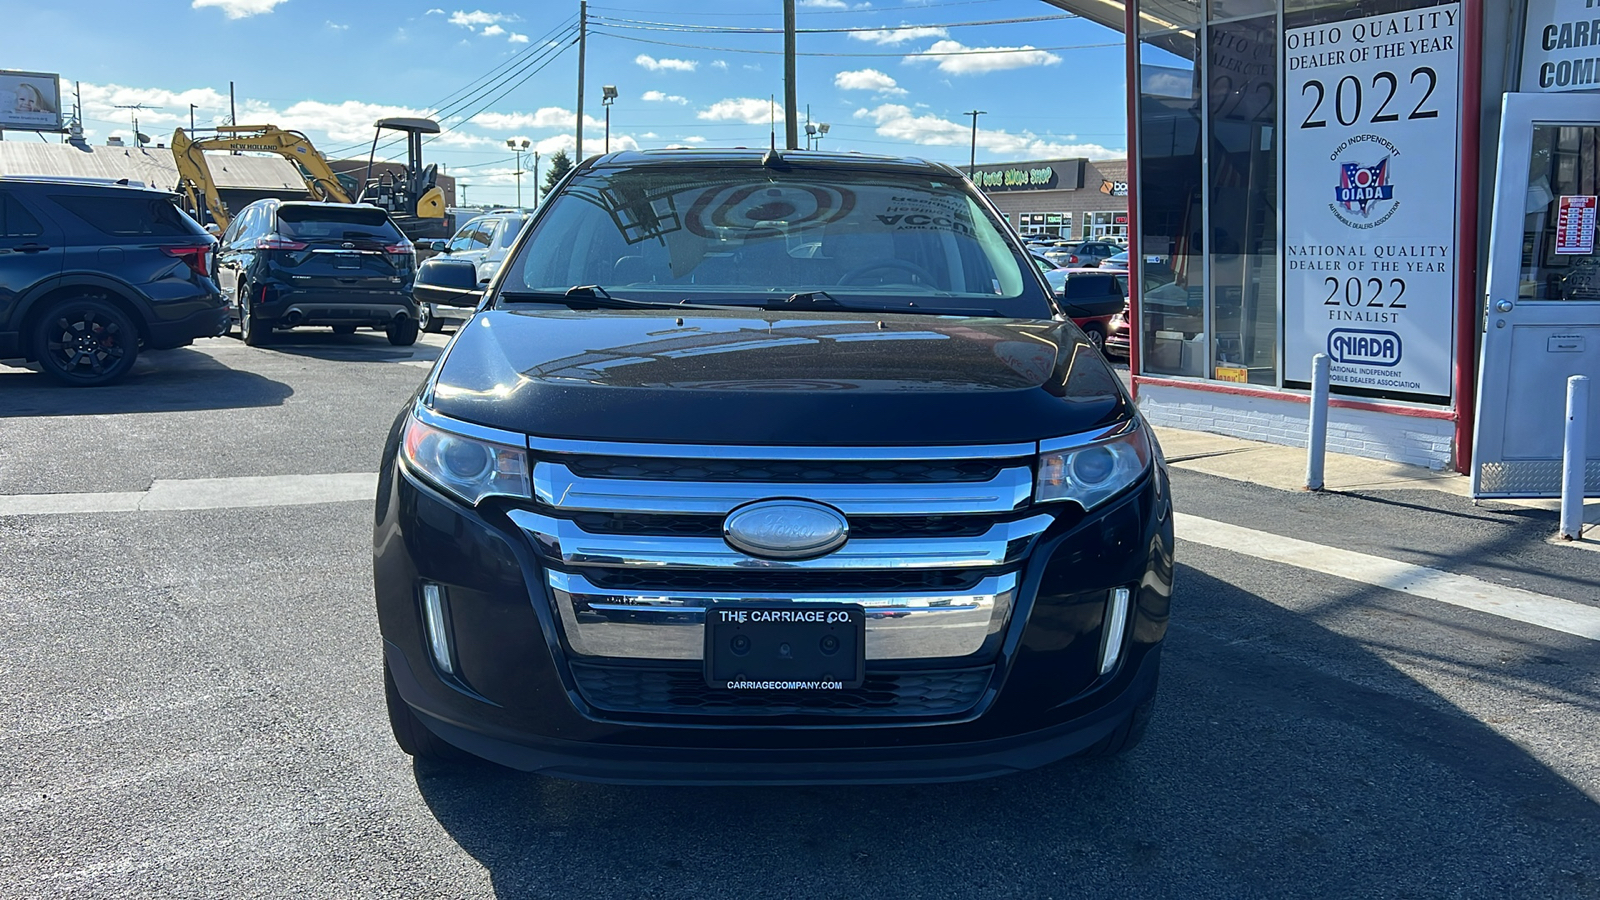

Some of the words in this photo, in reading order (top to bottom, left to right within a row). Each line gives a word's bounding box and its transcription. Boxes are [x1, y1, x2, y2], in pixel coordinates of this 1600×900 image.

[1287, 27, 1342, 50] OHIO
[1352, 8, 1458, 43] QUALITY
[1289, 50, 1346, 71] DEALER
[1349, 47, 1369, 63] OF
[1373, 42, 1405, 60] THE
[1410, 35, 1454, 55] YEAR
[1300, 66, 1439, 129] 2022
[1330, 142, 1347, 161] OHIO
[1347, 134, 1400, 157] INDEPENDENT
[1004, 168, 1029, 186] SMOKE
[1030, 166, 1053, 185] SHOP
[1341, 186, 1383, 201] OIADA
[1328, 203, 1352, 228] AUTOMOBILE
[1374, 200, 1400, 227] ASSOCIATION
[1288, 245, 1366, 256] NATIONAL
[1374, 245, 1449, 258] QUALITY
[1289, 260, 1341, 271] DEALER
[1347, 261, 1365, 271] OF
[1371, 261, 1399, 272] THE
[1406, 262, 1446, 273] YEAR
[1324, 276, 1407, 309] 2022
[1328, 310, 1399, 323] FINALIST
[1333, 335, 1395, 359] NIADA
[1329, 366, 1358, 374] NATIONAL
[1359, 368, 1402, 378] INDEPENDENT
[1349, 376, 1376, 385] DEALERS
[1376, 379, 1421, 389] ASSOCIATION
[761, 513, 815, 538] Ford
[719, 610, 748, 623] THE
[751, 610, 825, 623] CARRIAGE
[827, 611, 852, 623] CO.
[726, 681, 843, 690] CARRIAGECOMPANY.COM
